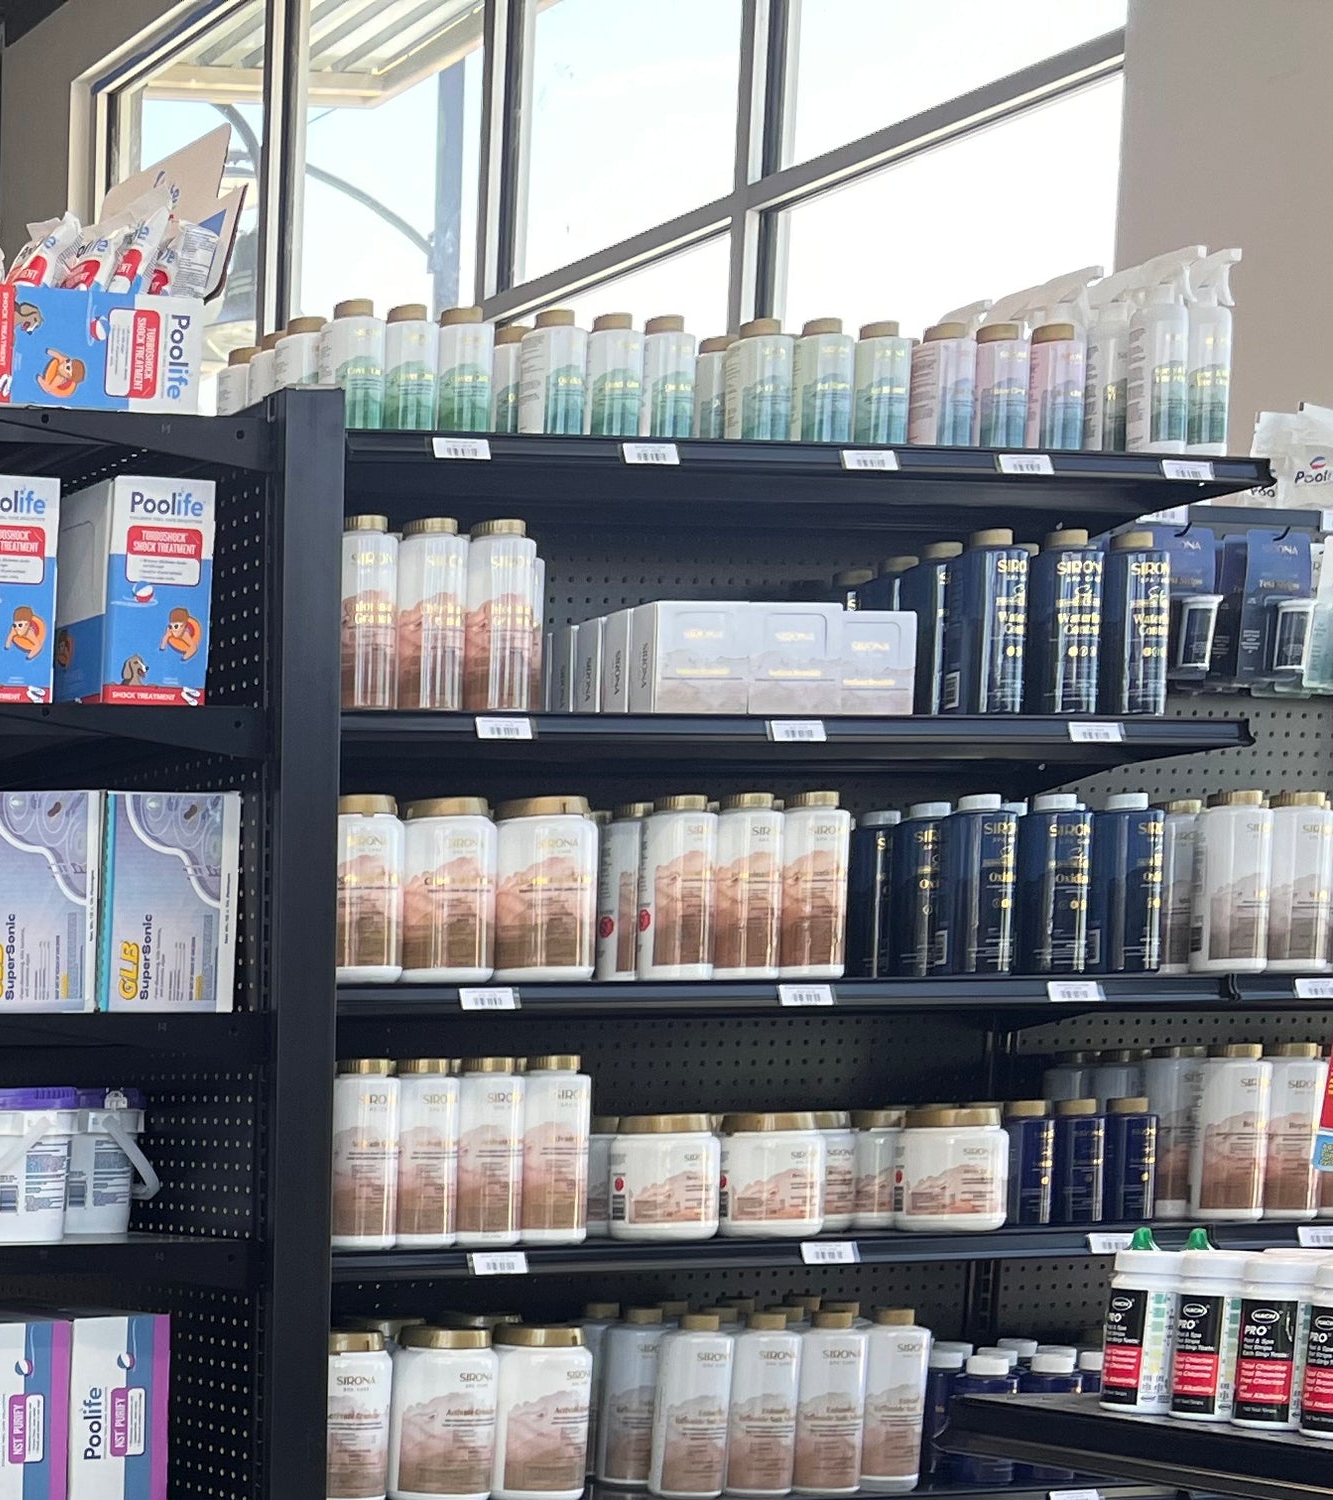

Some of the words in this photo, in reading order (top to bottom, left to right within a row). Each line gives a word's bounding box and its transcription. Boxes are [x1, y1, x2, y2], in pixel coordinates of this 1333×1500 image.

[0, 291, 10, 319] SHOCK
[136, 316, 148, 345] SHOCK
[132, 344, 146, 392] TREATMENT
[166, 314, 192, 400] Poolife
[130, 490, 205, 518] Poolife
[0, 541, 39, 554] TREATMENT
[132, 541, 157, 553] SHOCK
[157, 542, 197, 556] TREATMENT
[141, 529, 188, 544] TURBOSHOCK
[997, 559, 1027, 574] SIRO
[111, 691, 136, 700] SHOCK
[136, 692, 176, 702] TREATMENT
[4, 912, 17, 1001] SuperSonic
[119, 940, 140, 1001] GLB
[139, 912, 153, 1001] SuperSonic
[1244, 1325, 1268, 1337] PRO
[336, 1375, 376, 1386] SIRONA
[1255, 1363, 1287, 1371] Chlorine
[13, 1404, 24, 1436] PURIFY
[83, 1387, 102, 1460] Poolife
[114, 1397, 126, 1429] PURIFY
[13, 1437, 24, 1455] NST
[114, 1430, 126, 1448] NST
